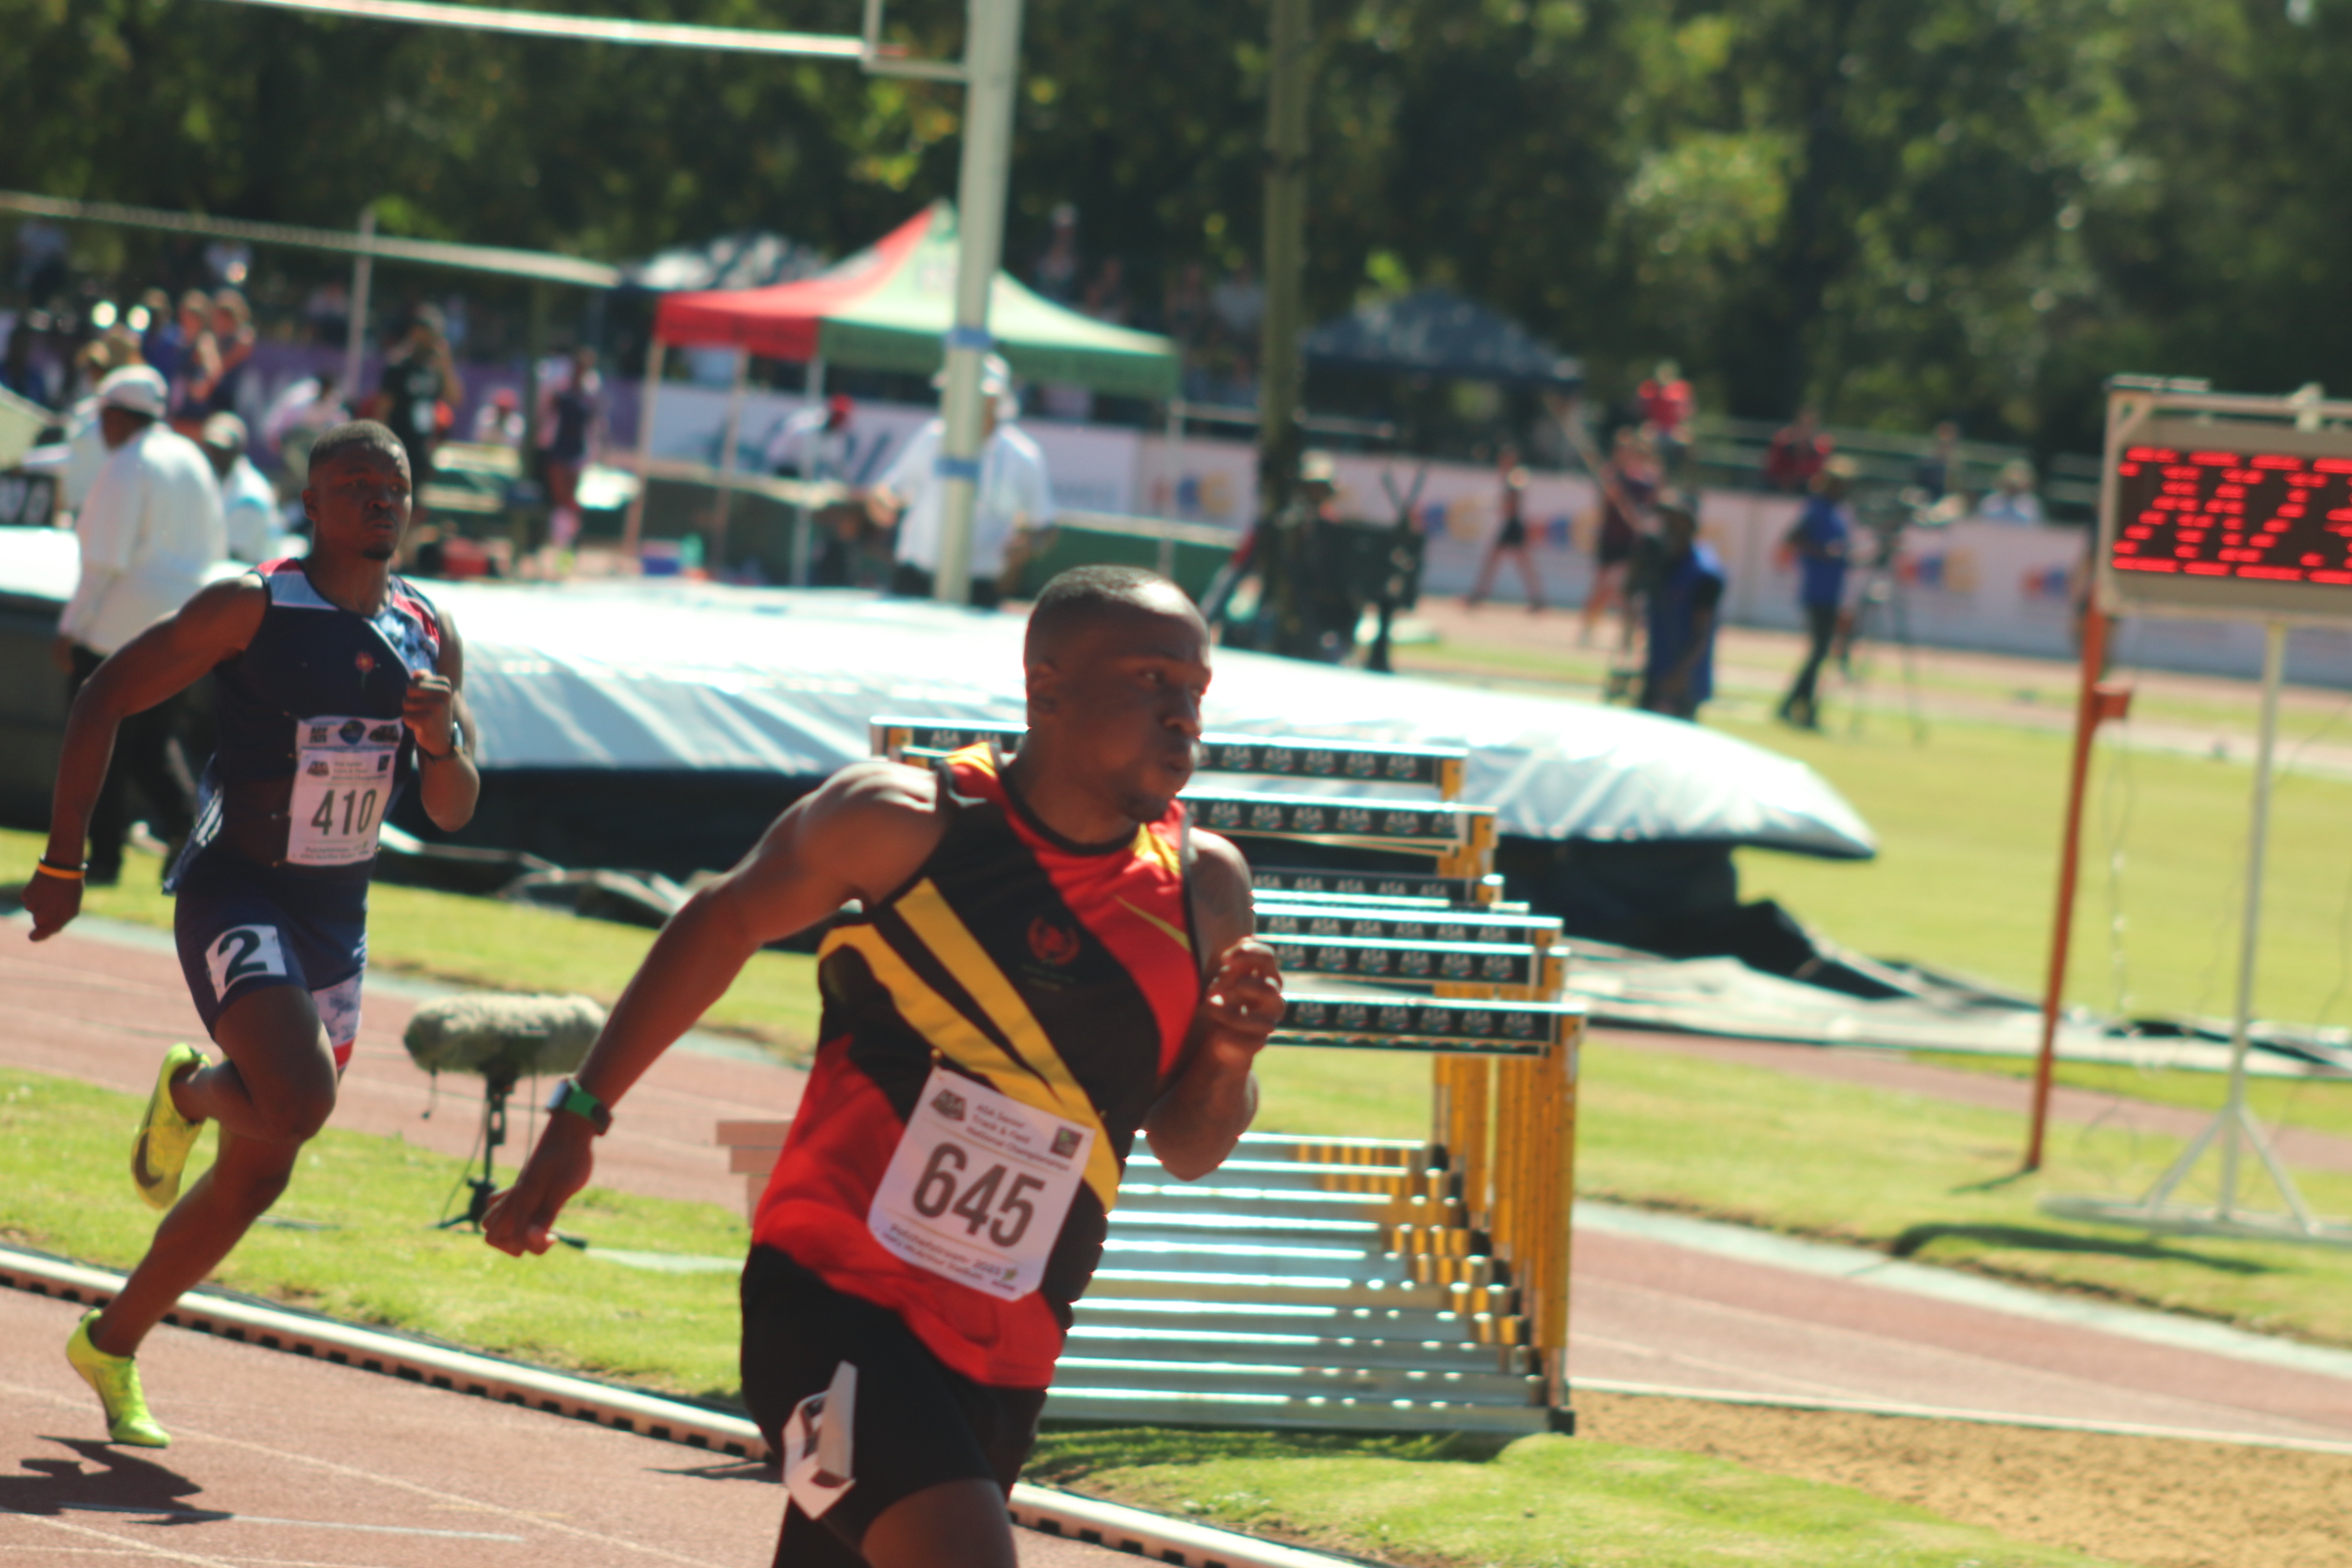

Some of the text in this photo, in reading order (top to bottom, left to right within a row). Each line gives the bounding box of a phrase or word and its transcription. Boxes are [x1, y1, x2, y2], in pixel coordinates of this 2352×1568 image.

[311, 789, 378, 836] 410
[217, 928, 269, 990] 2
[911, 1141, 1047, 1248] 645
